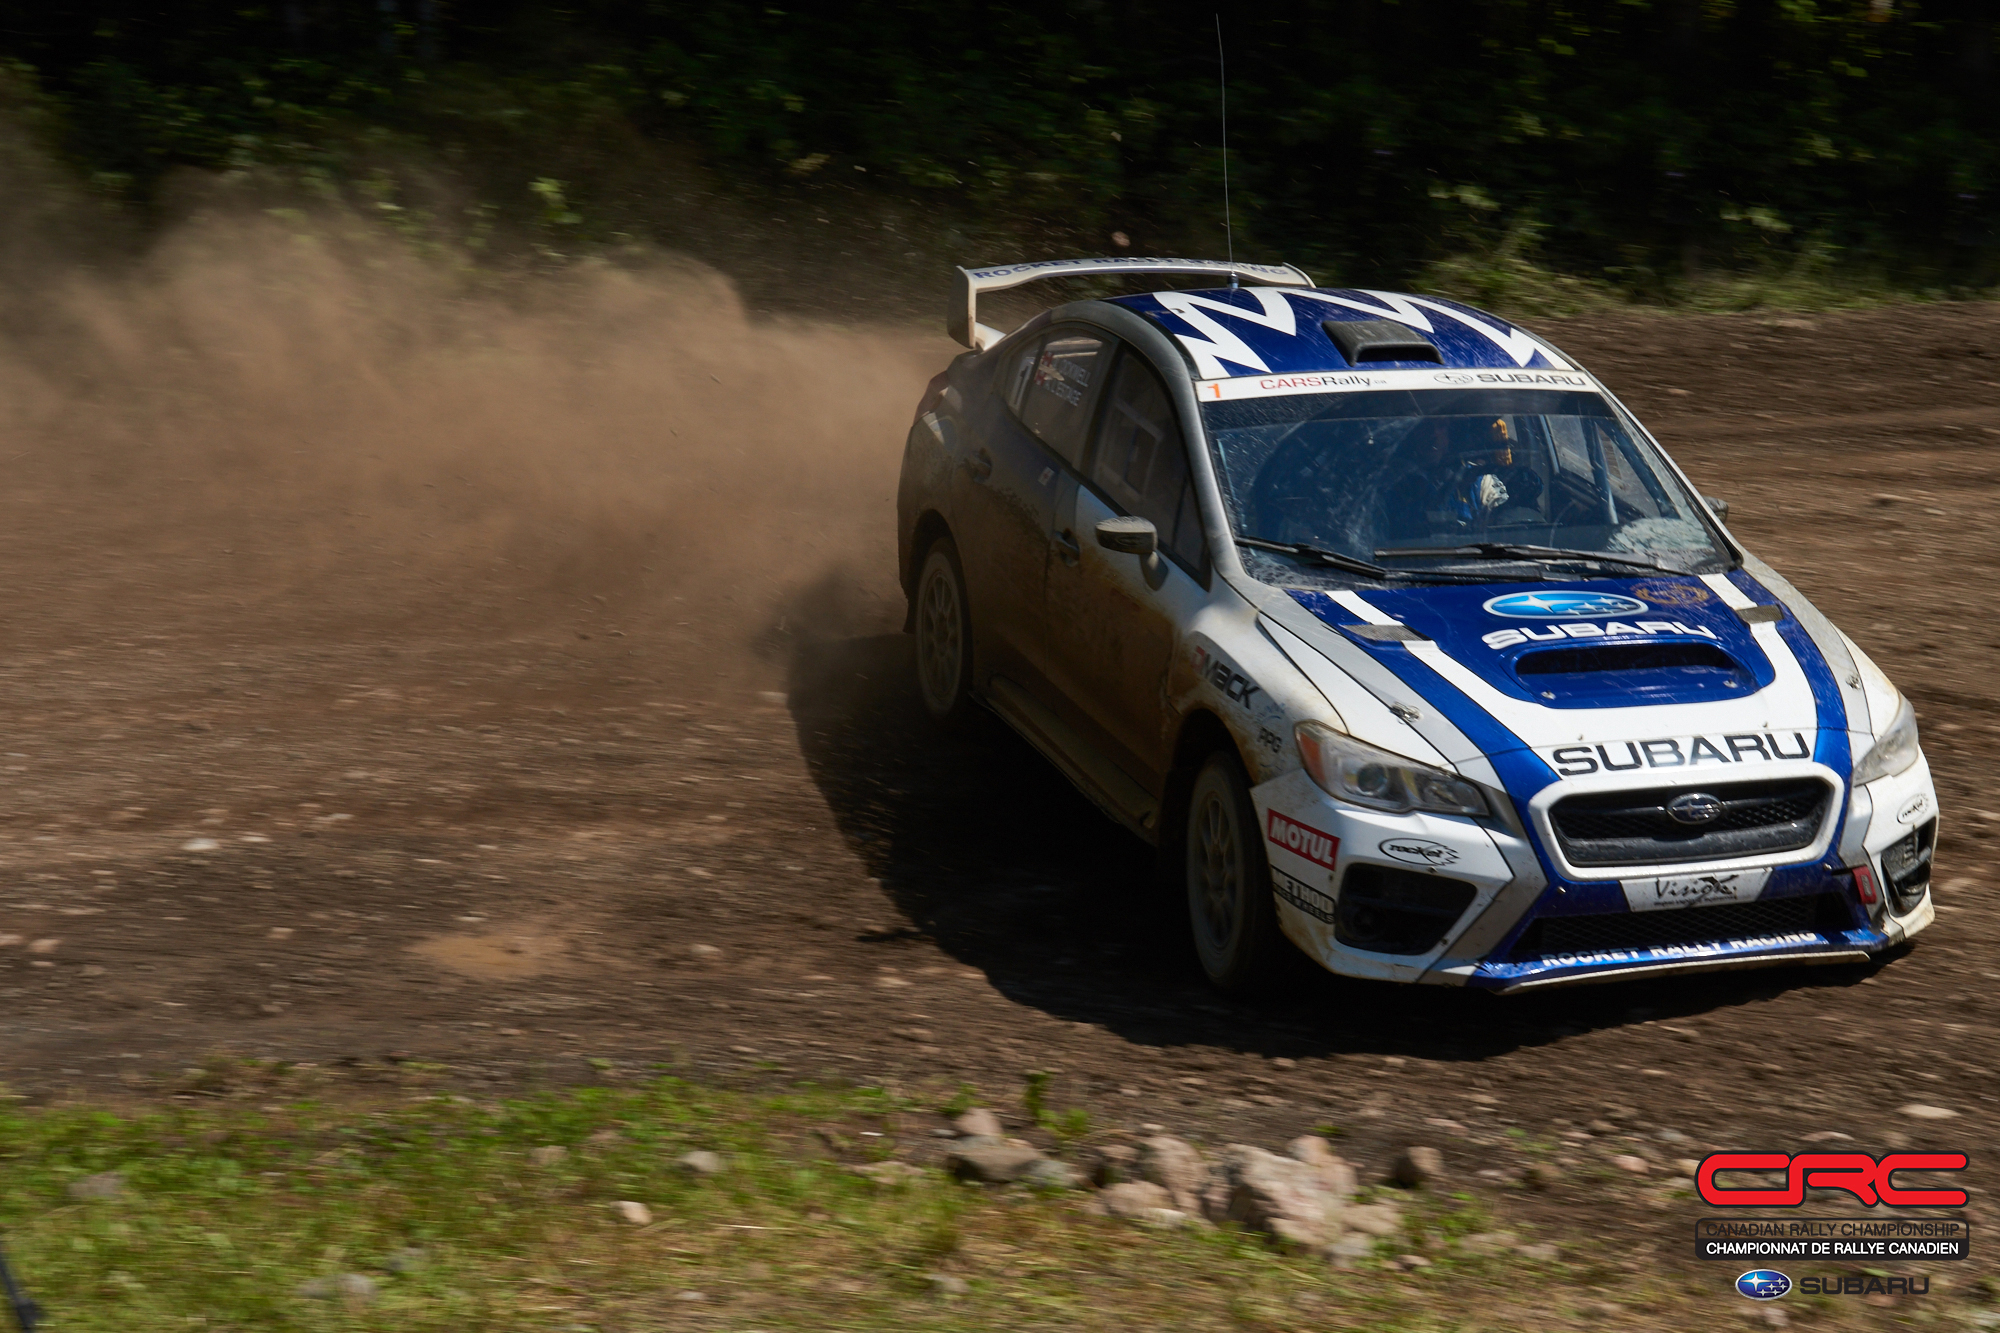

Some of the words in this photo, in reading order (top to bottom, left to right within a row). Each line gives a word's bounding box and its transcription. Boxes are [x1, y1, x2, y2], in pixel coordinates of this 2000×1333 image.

[1206, 383, 1220, 399] 1
[1477, 372, 1587, 387] SUBARU
[1482, 621, 1716, 650] SUBARU
[1553, 732, 1811, 777] SUBARU
[1270, 816, 1333, 864] MOTUL
[1540, 947, 1640, 968] ROCKET
[1650, 938, 1723, 958] RALLY
[1730, 930, 1818, 949] RACING
